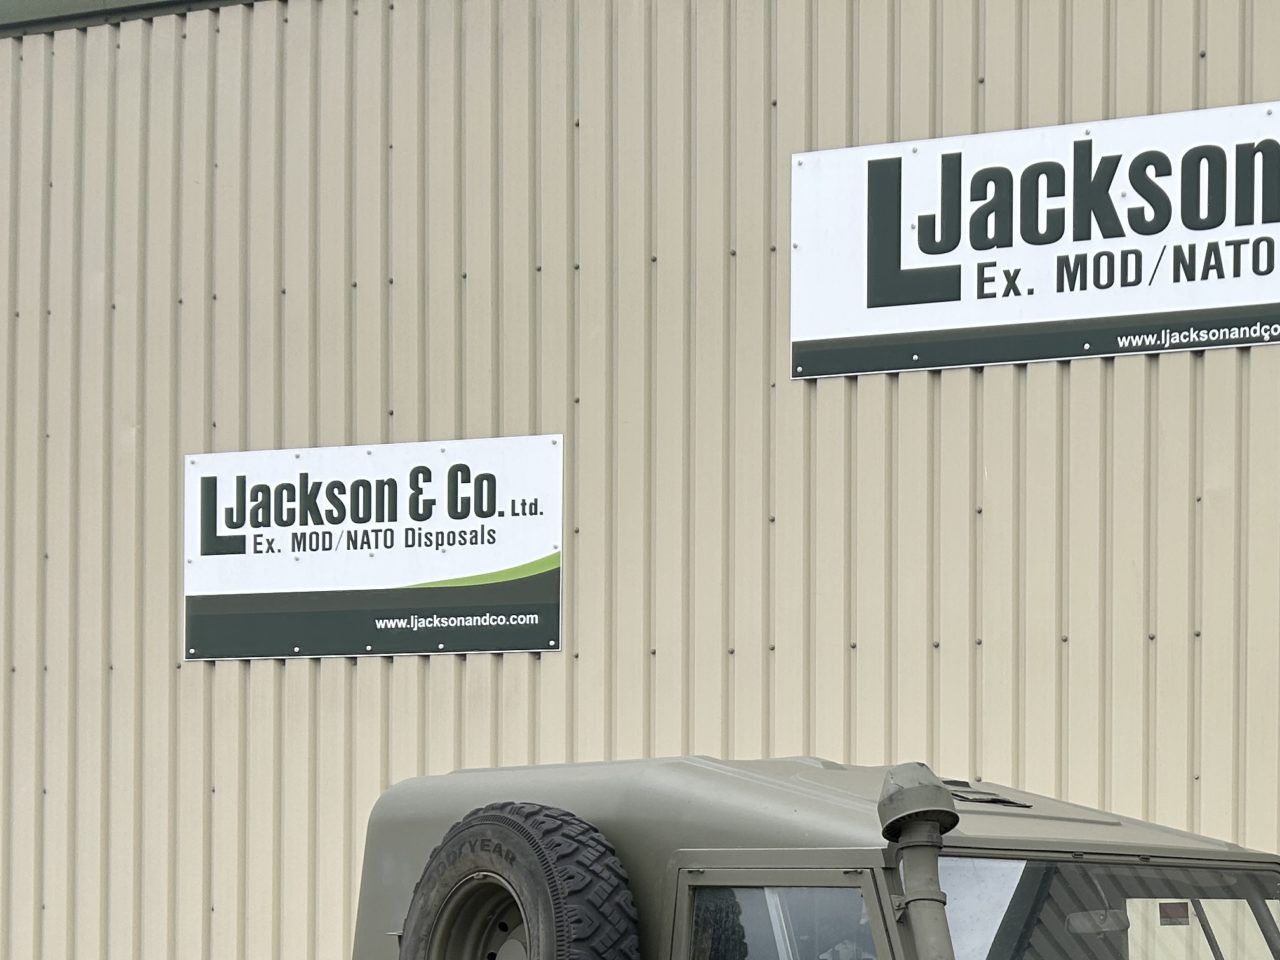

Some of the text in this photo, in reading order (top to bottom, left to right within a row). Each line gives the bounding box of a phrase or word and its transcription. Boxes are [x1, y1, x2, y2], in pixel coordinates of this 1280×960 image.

[976, 261, 1035, 300] Ex.
[1056, 236, 1275, 293] MOD/NATO
[408, 465, 437, 522] &
[447, 463, 505, 520] Co.
[511, 497, 544, 517] Ltd.
[253, 524, 496, 554] Ex. MOD/NATO Disposals
[375, 612, 539, 631] www.ljacksonandco.com
